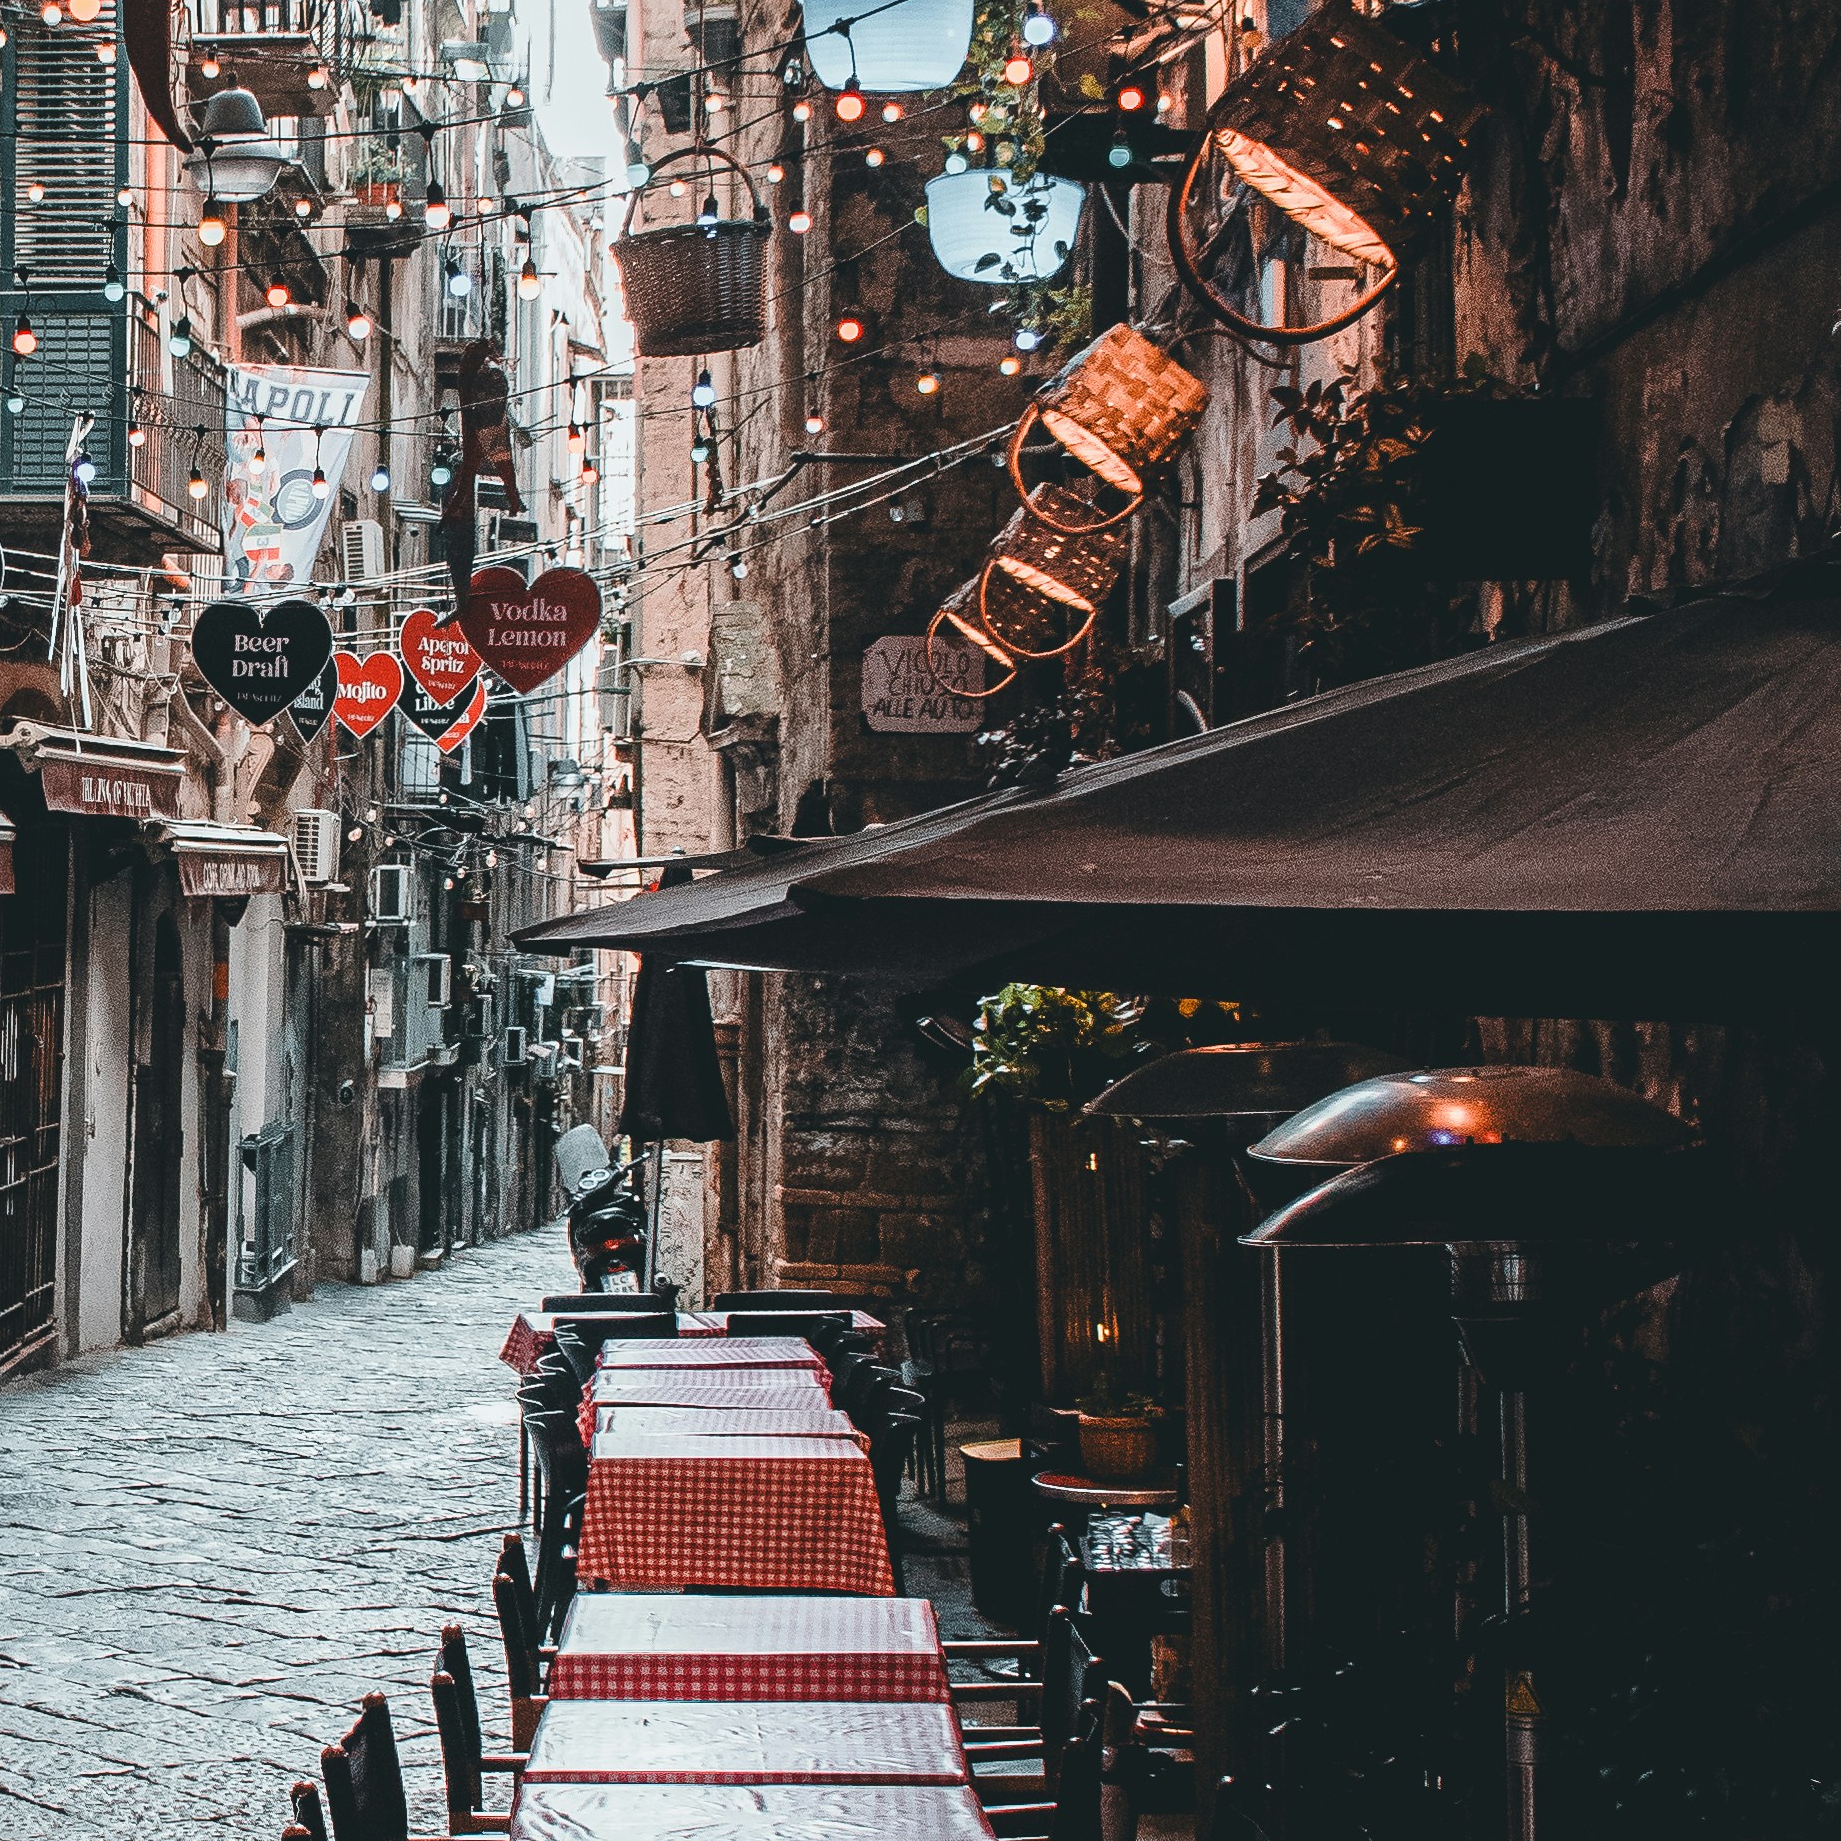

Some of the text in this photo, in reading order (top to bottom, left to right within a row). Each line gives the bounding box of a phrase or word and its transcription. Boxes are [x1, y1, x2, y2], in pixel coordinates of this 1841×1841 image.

[490, 598, 568, 622] Vodka
[234, 634, 289, 652] Beer
[487, 627, 567, 647] Lemon
[232, 655, 288, 678] Draft
[421, 655, 465, 675] Spritz
[337, 681, 387, 704] Mojito
[414, 695, 456, 712] Libe
